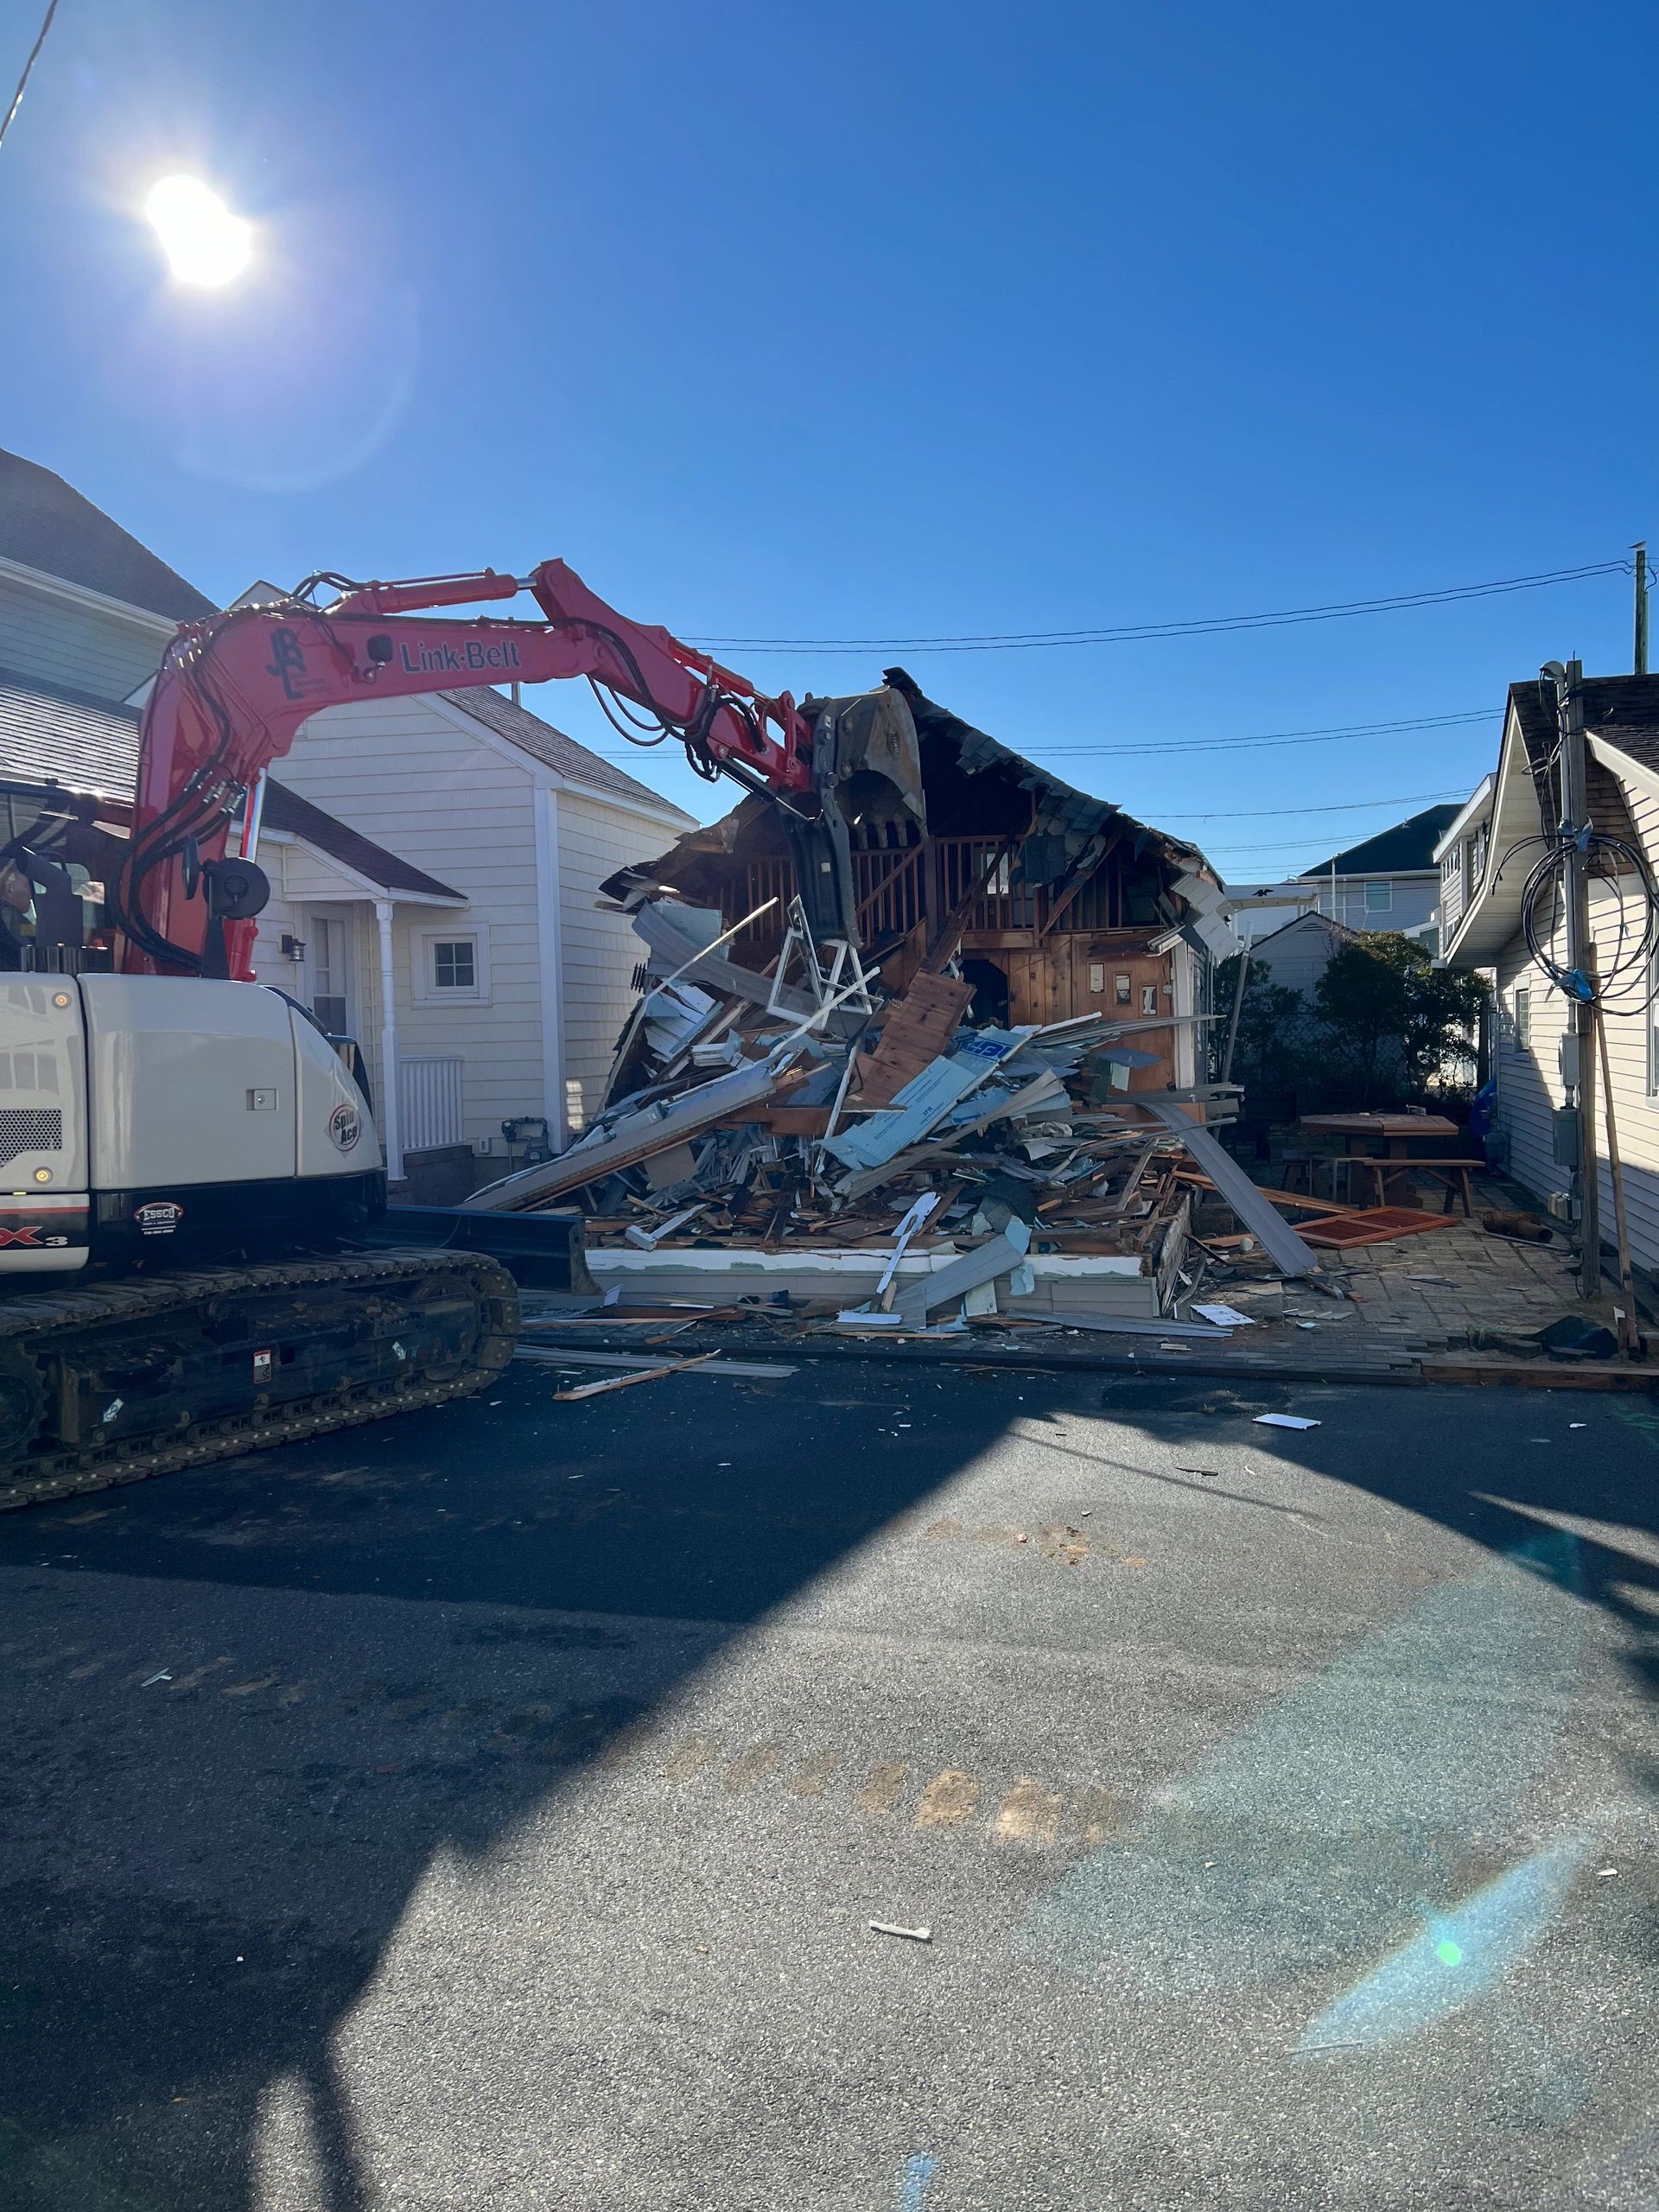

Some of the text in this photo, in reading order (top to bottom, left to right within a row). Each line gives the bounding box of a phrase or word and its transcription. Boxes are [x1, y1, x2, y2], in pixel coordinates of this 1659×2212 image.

[400, 640, 521, 673] Link-Belt
[334, 1109, 355, 1130] Spin
[340, 1125, 358, 1145] Ace
